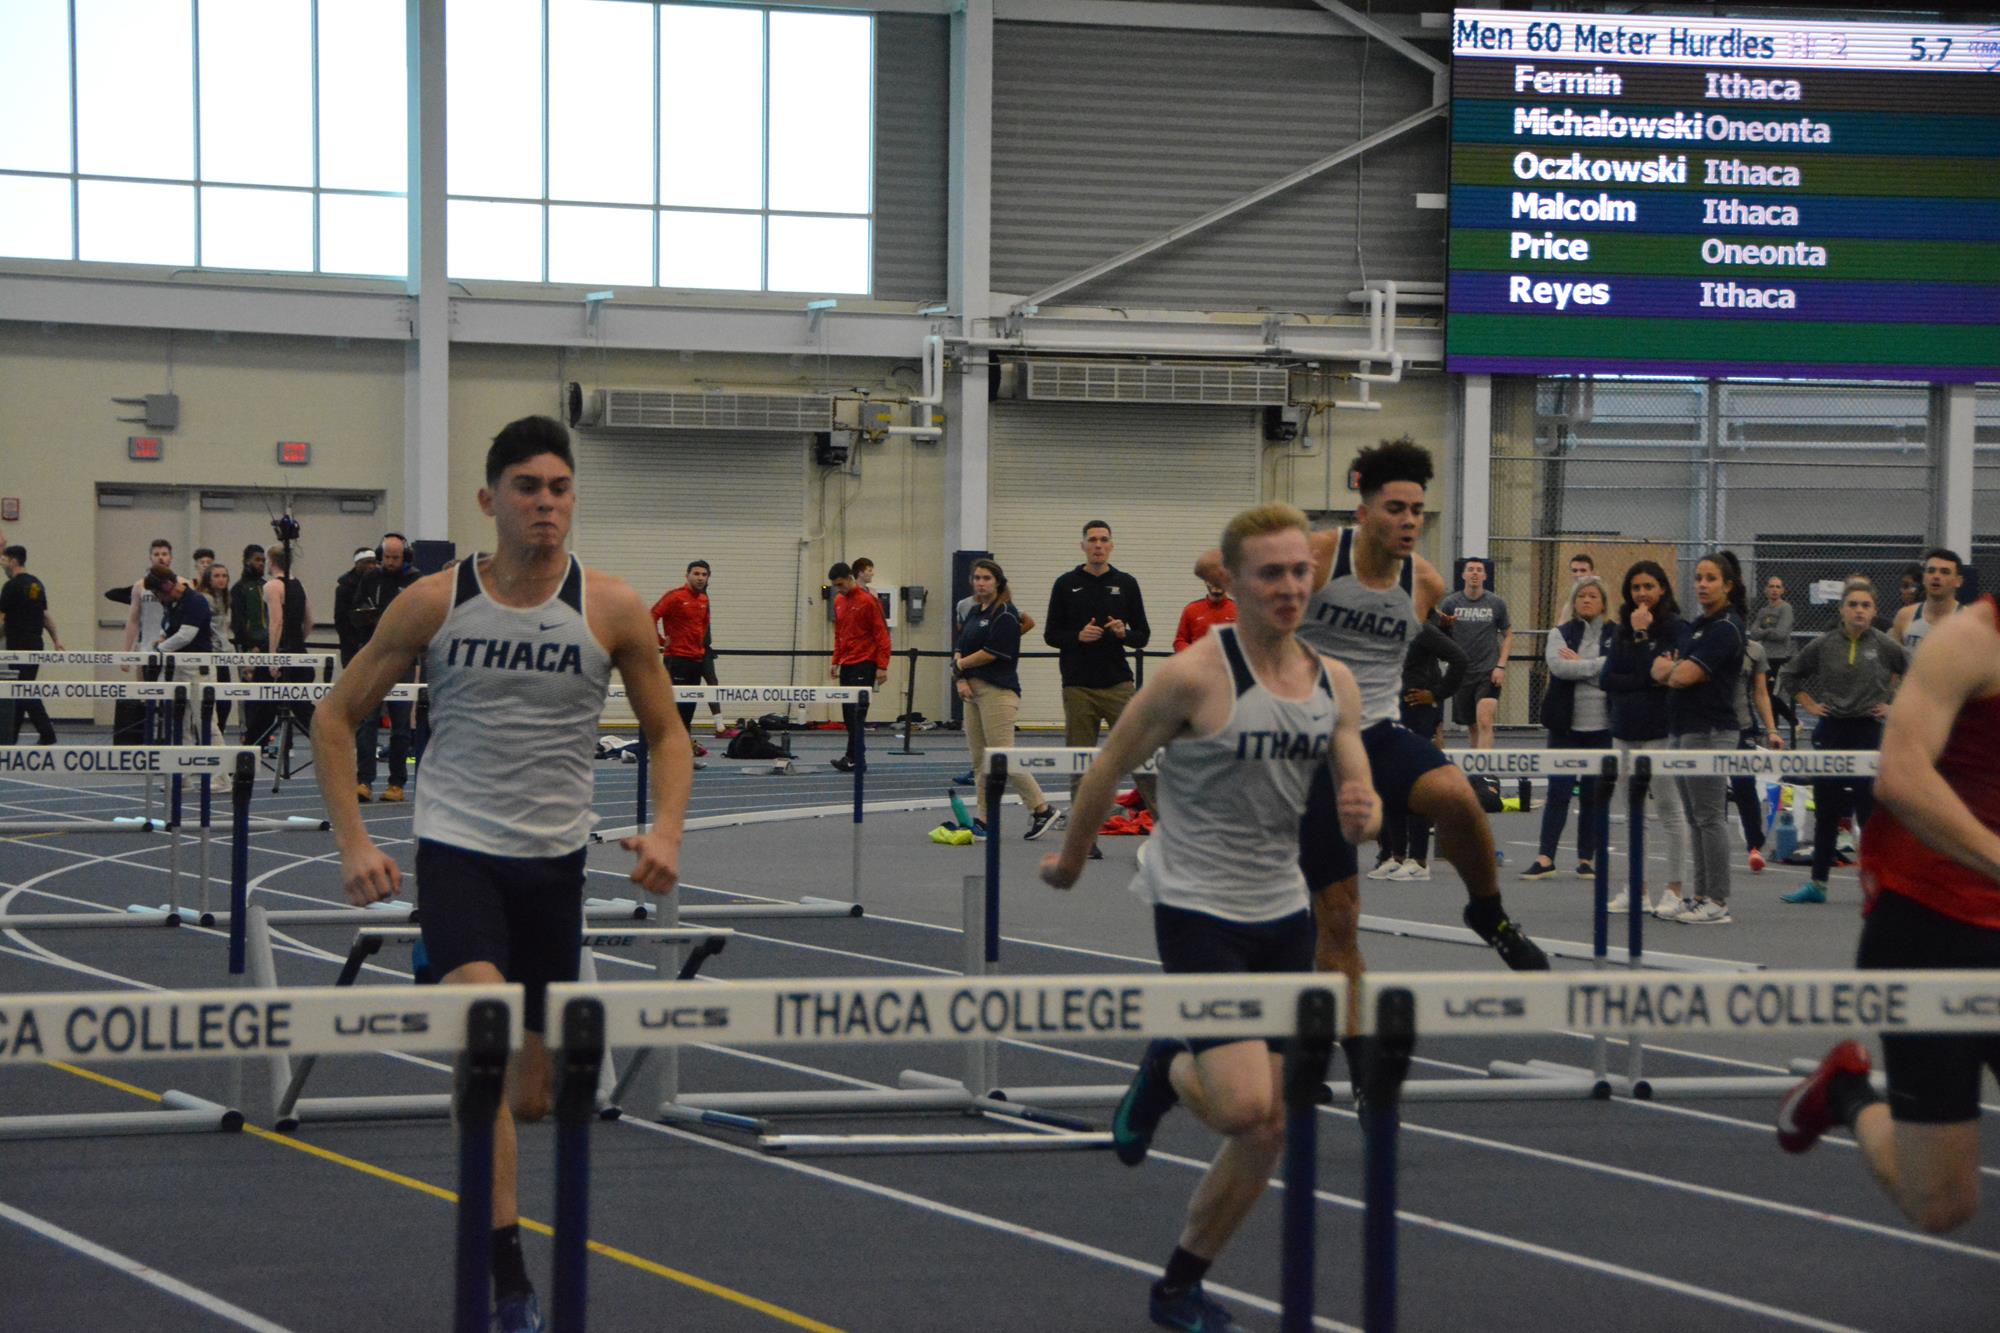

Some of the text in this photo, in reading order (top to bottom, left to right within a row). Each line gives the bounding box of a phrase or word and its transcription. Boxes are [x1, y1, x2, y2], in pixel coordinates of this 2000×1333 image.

[1456, 19, 1514, 50] Men
[1526, 22, 1562, 52] 60
[1574, 24, 1656, 55] Meter
[1669, 27, 1775, 59] Hurdles
[1514, 66, 1801, 100] Fermin Ithaca
[1514, 108, 1831, 143] Michalowski Oneonta
[1513, 152, 1800, 186] Oczkowski Ithaca
[1511, 192, 1799, 226] Malcolm Ithaca
[1510, 233, 1826, 267] Price Oneonta
[1509, 277, 1796, 310] Reyes Ithaca
[1317, 602, 1408, 642] ITHACA
[1454, 607, 1493, 618] ITHACA
[29, 653, 64, 663] ITHACA
[68, 653, 113, 664] COLLEGE
[211, 655, 245, 665] ITHACA
[248, 656, 292, 666] COLLEGE
[447, 637, 583, 674] ITHACA
[11, 684, 60, 697] ITHACA
[65, 684, 127, 697] COLLEGE
[259, 686, 310, 700] ITHACA
[716, 689, 759, 701] ITHACA
[763, 689, 817, 701] COLLEGE
[0, 751, 220, 771] HACA COLLEGE UCS
[1019, 757, 1056, 767] UCS
[1236, 731, 1329, 760] ITHAC
[1463, 754, 1540, 772] COLLEGE
[1554, 760, 1587, 768] UCS
[1663, 760, 1697, 769] UCS
[1713, 755, 1774, 773] ITHACA
[1779, 756, 1856, 774] COLLEGE
[640, 988, 1263, 1036] UCS ITHACA COLLEGE UCS
[1444, 984, 2000, 1026] UCS ITHACA COLLEGE UC
[65, 1003, 292, 1054] COLLEGE
[334, 1013, 429, 1034] UCS
